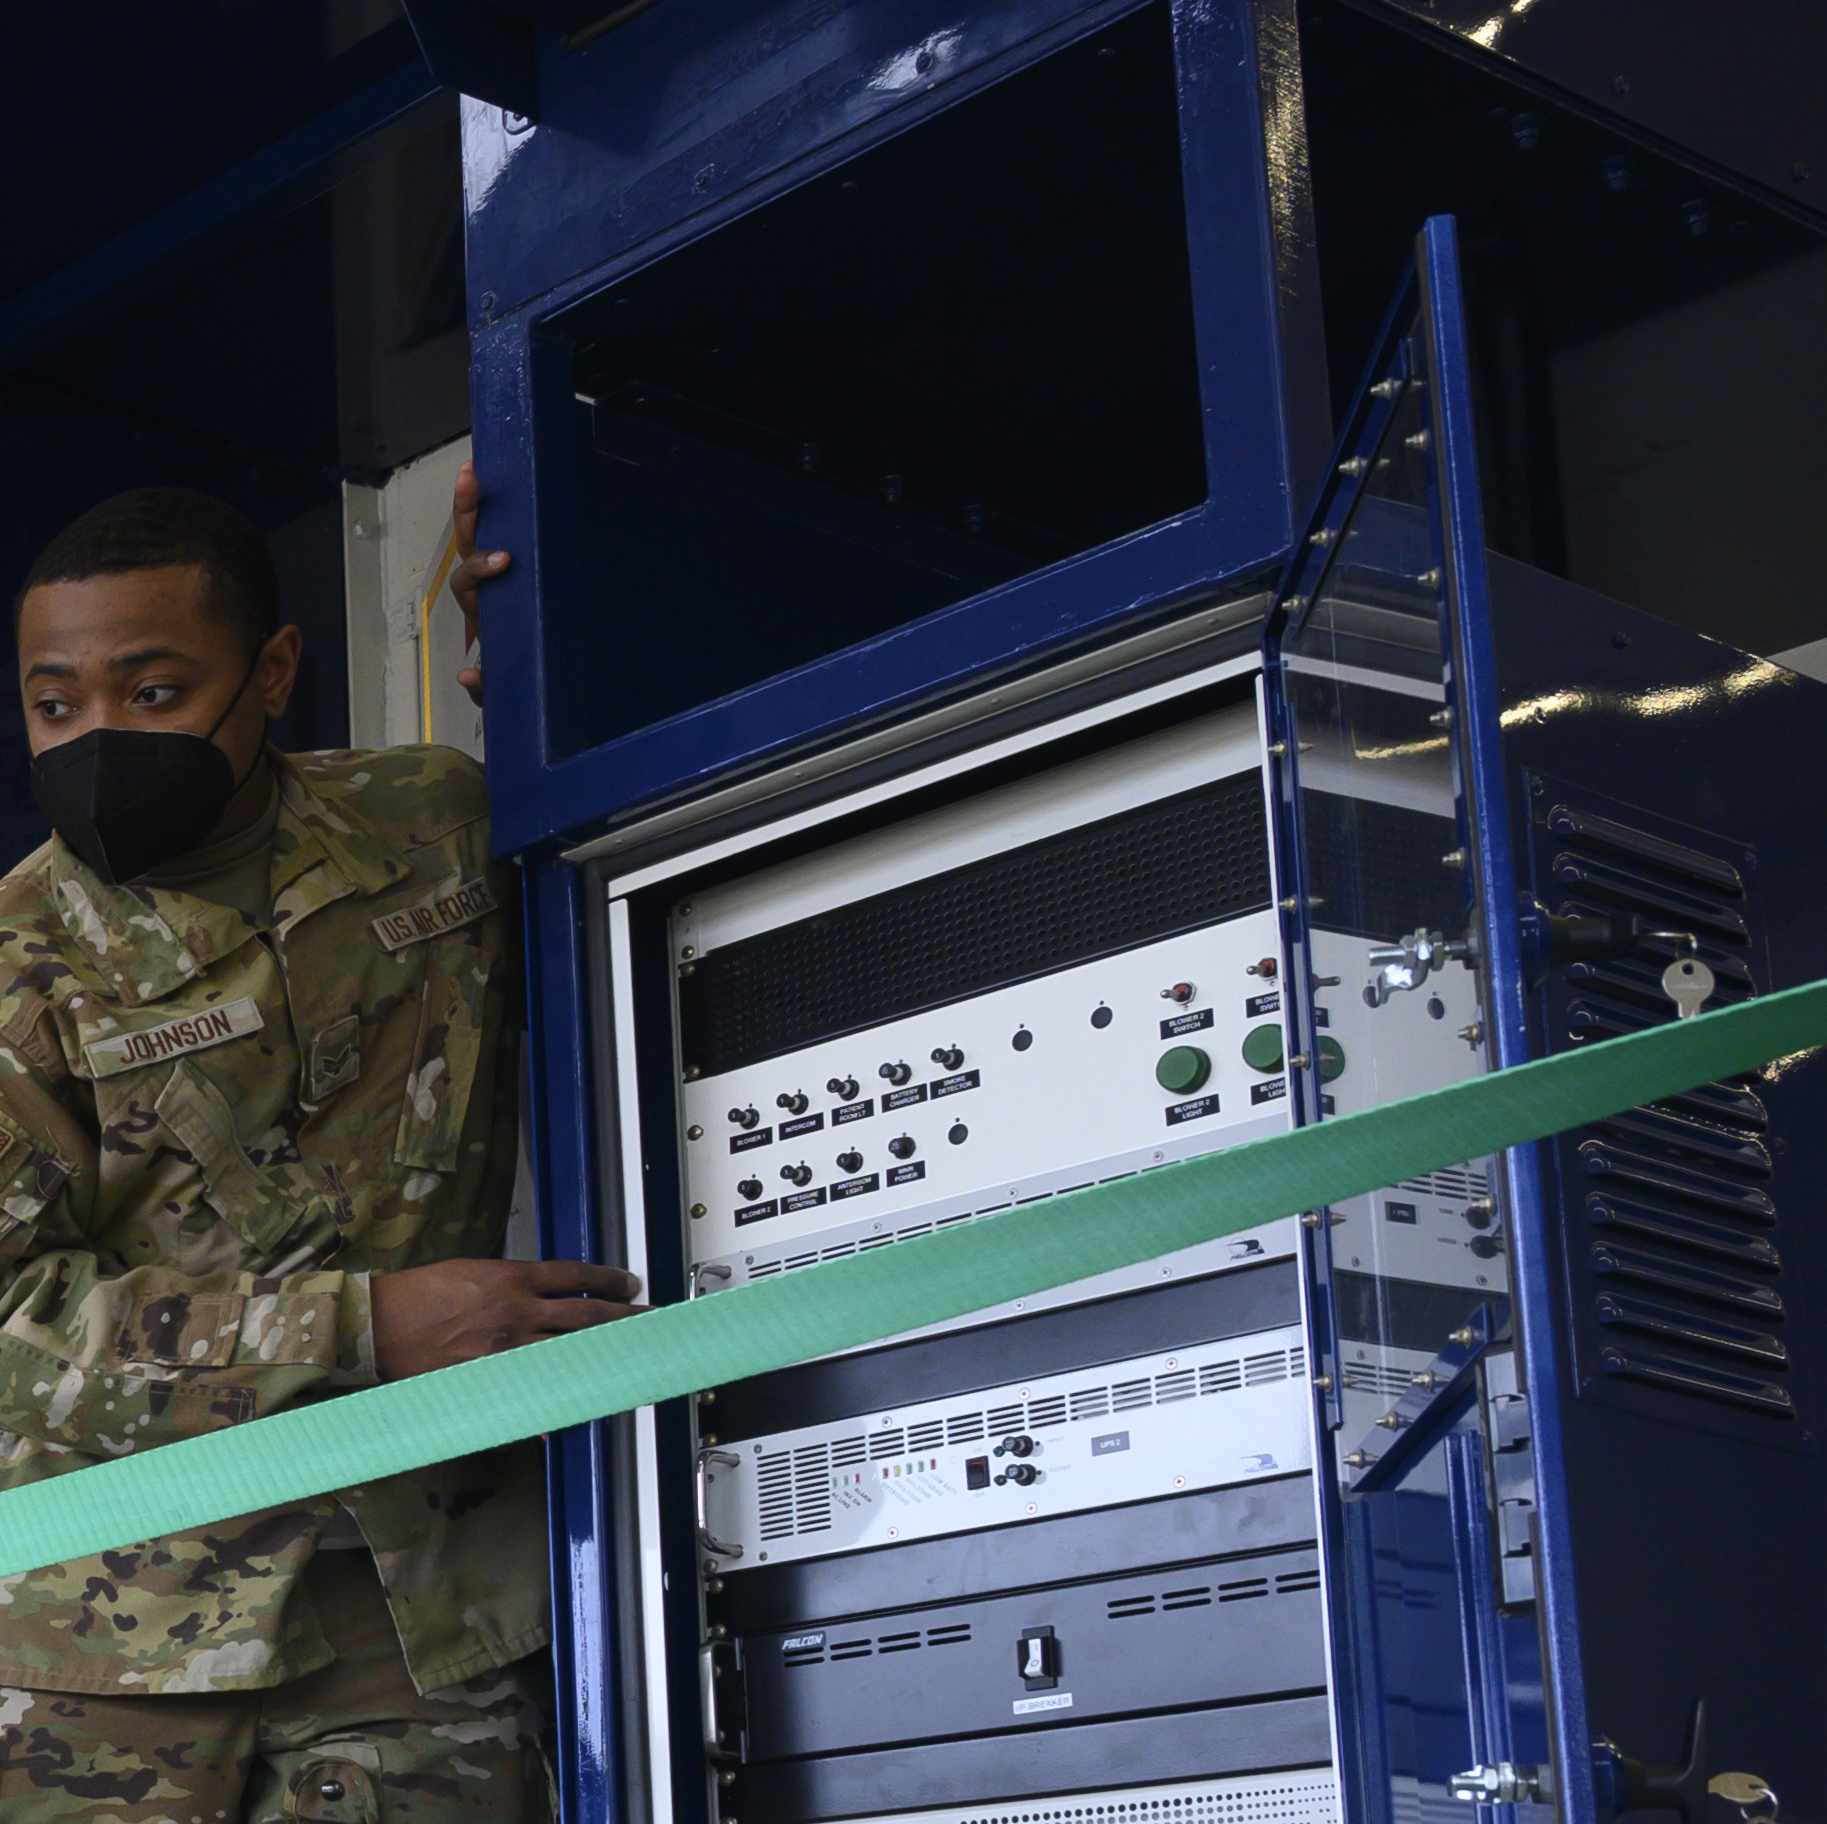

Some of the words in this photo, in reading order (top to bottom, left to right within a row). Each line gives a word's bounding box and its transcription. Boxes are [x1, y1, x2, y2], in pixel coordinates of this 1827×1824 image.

[381, 915, 413, 943] US
[409, 906, 440, 936] AIR
[434, 882, 492, 925] FORCE
[1255, 993, 1279, 1005] BLOWE
[1168, 1014, 1199, 1028] BLOWER
[1199, 1012, 1205, 1020] 2
[1173, 1021, 1201, 1034] SWITCH
[120, 1009, 233, 1064] JOHNSON
[938, 1079, 973, 1095] DETECTOR
[943, 1075, 966, 1087] SMOKE
[1260, 1081, 1285, 1093] BLOWE
[890, 1087, 919, 1101] BATTERY
[1268, 1089, 1286, 1098] LIGH
[889, 1094, 920, 1108] CHARGER
[1174, 1100, 1205, 1114] BLOWER
[1205, 1099, 1210, 1107] 2
[839, 1103, 865, 1116] PATIENT
[1182, 1108, 1203, 1119] LIGHT
[839, 1112, 858, 1123] ROOM
[785, 1119, 816, 1133] INTERCOM
[736, 1135, 762, 1147] BLOWER
[837, 1177, 873, 1191] ANTEROOM
[894, 1171, 919, 1183] POWER
[787, 1190, 820, 1204] PRESSURE
[845, 1186, 864, 1197] LIGHT
[788, 1199, 818, 1212] CONTROL
[741, 1208, 765, 1220] BLOWER
[766, 1206, 772, 1214] 2
[1100, 1440, 1115, 1449] UPS
[1116, 1438, 1121, 1446] 2
[854, 1488, 872, 1503] ALARM
[782, 1635, 823, 1650] FALCON
[1027, 1697, 1070, 1712] BREAKER
